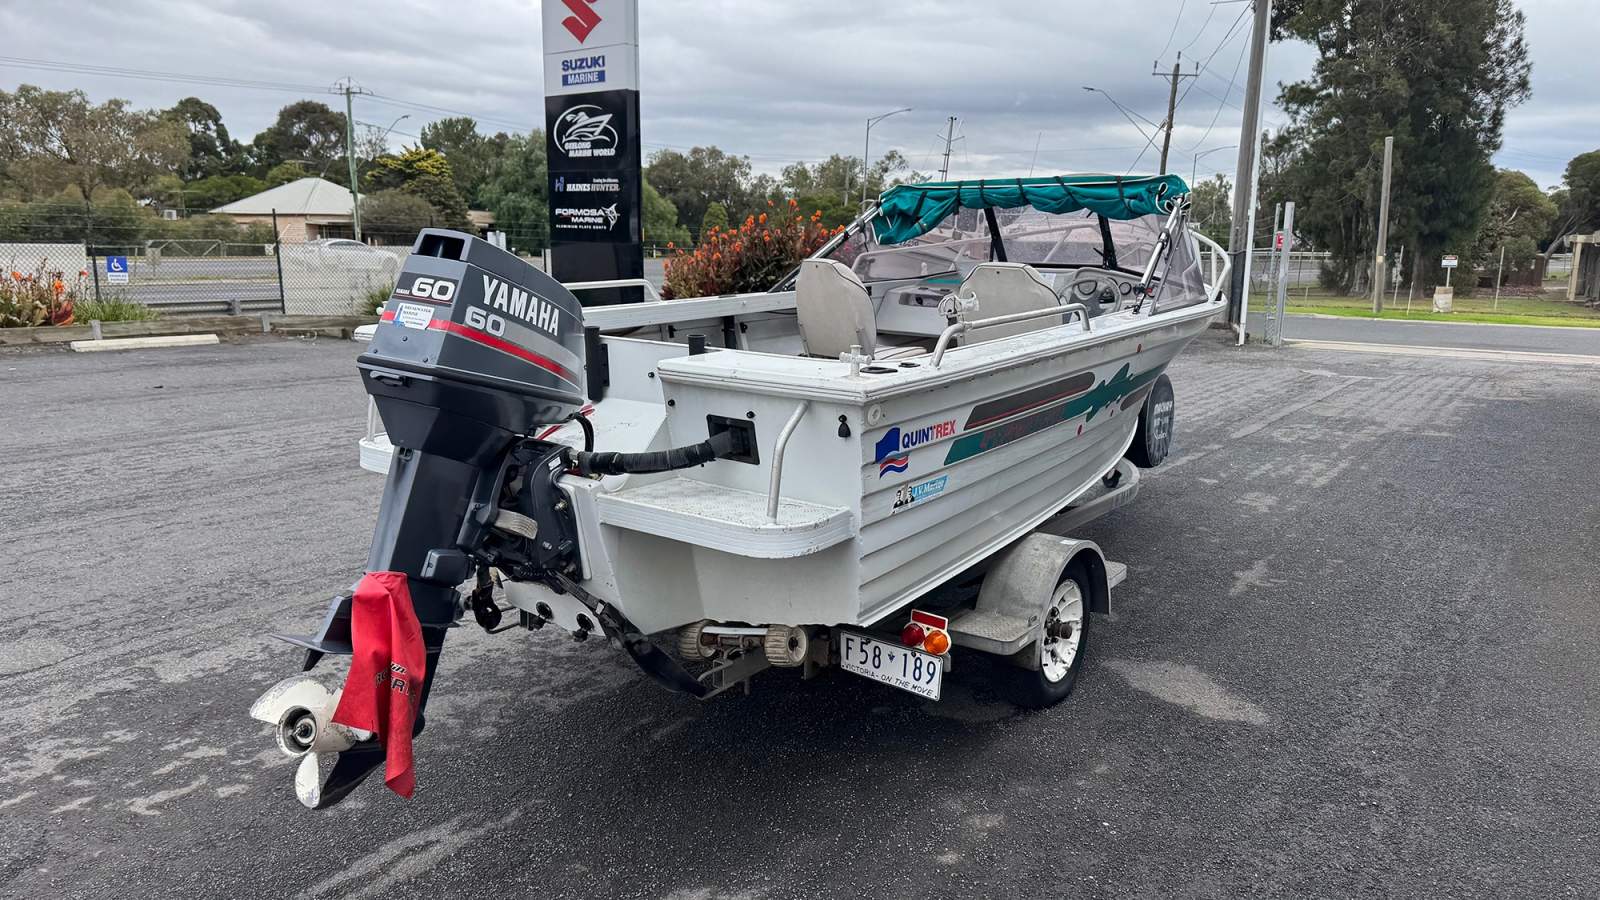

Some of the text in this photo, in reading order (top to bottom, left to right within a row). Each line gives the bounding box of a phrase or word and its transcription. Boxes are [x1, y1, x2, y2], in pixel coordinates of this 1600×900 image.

[562, 55, 605, 72] SUZUKI
[567, 71, 600, 84] MARINE
[564, 141, 591, 150] GEELONG
[568, 147, 616, 158] MARINE WORLD
[566, 183, 620, 192] HAINES HUNTER
[555, 208, 606, 216] FORMOSA
[411, 277, 456, 301] 60
[482, 274, 560, 337] YAMAHA
[465, 305, 506, 337] 60
[902, 420, 957, 449] QUINTREX
[845, 637, 937, 685] F58 189
[881, 675, 893, 683] ON
[894, 678, 911, 689] THE
[912, 683, 935, 697] MOVE
